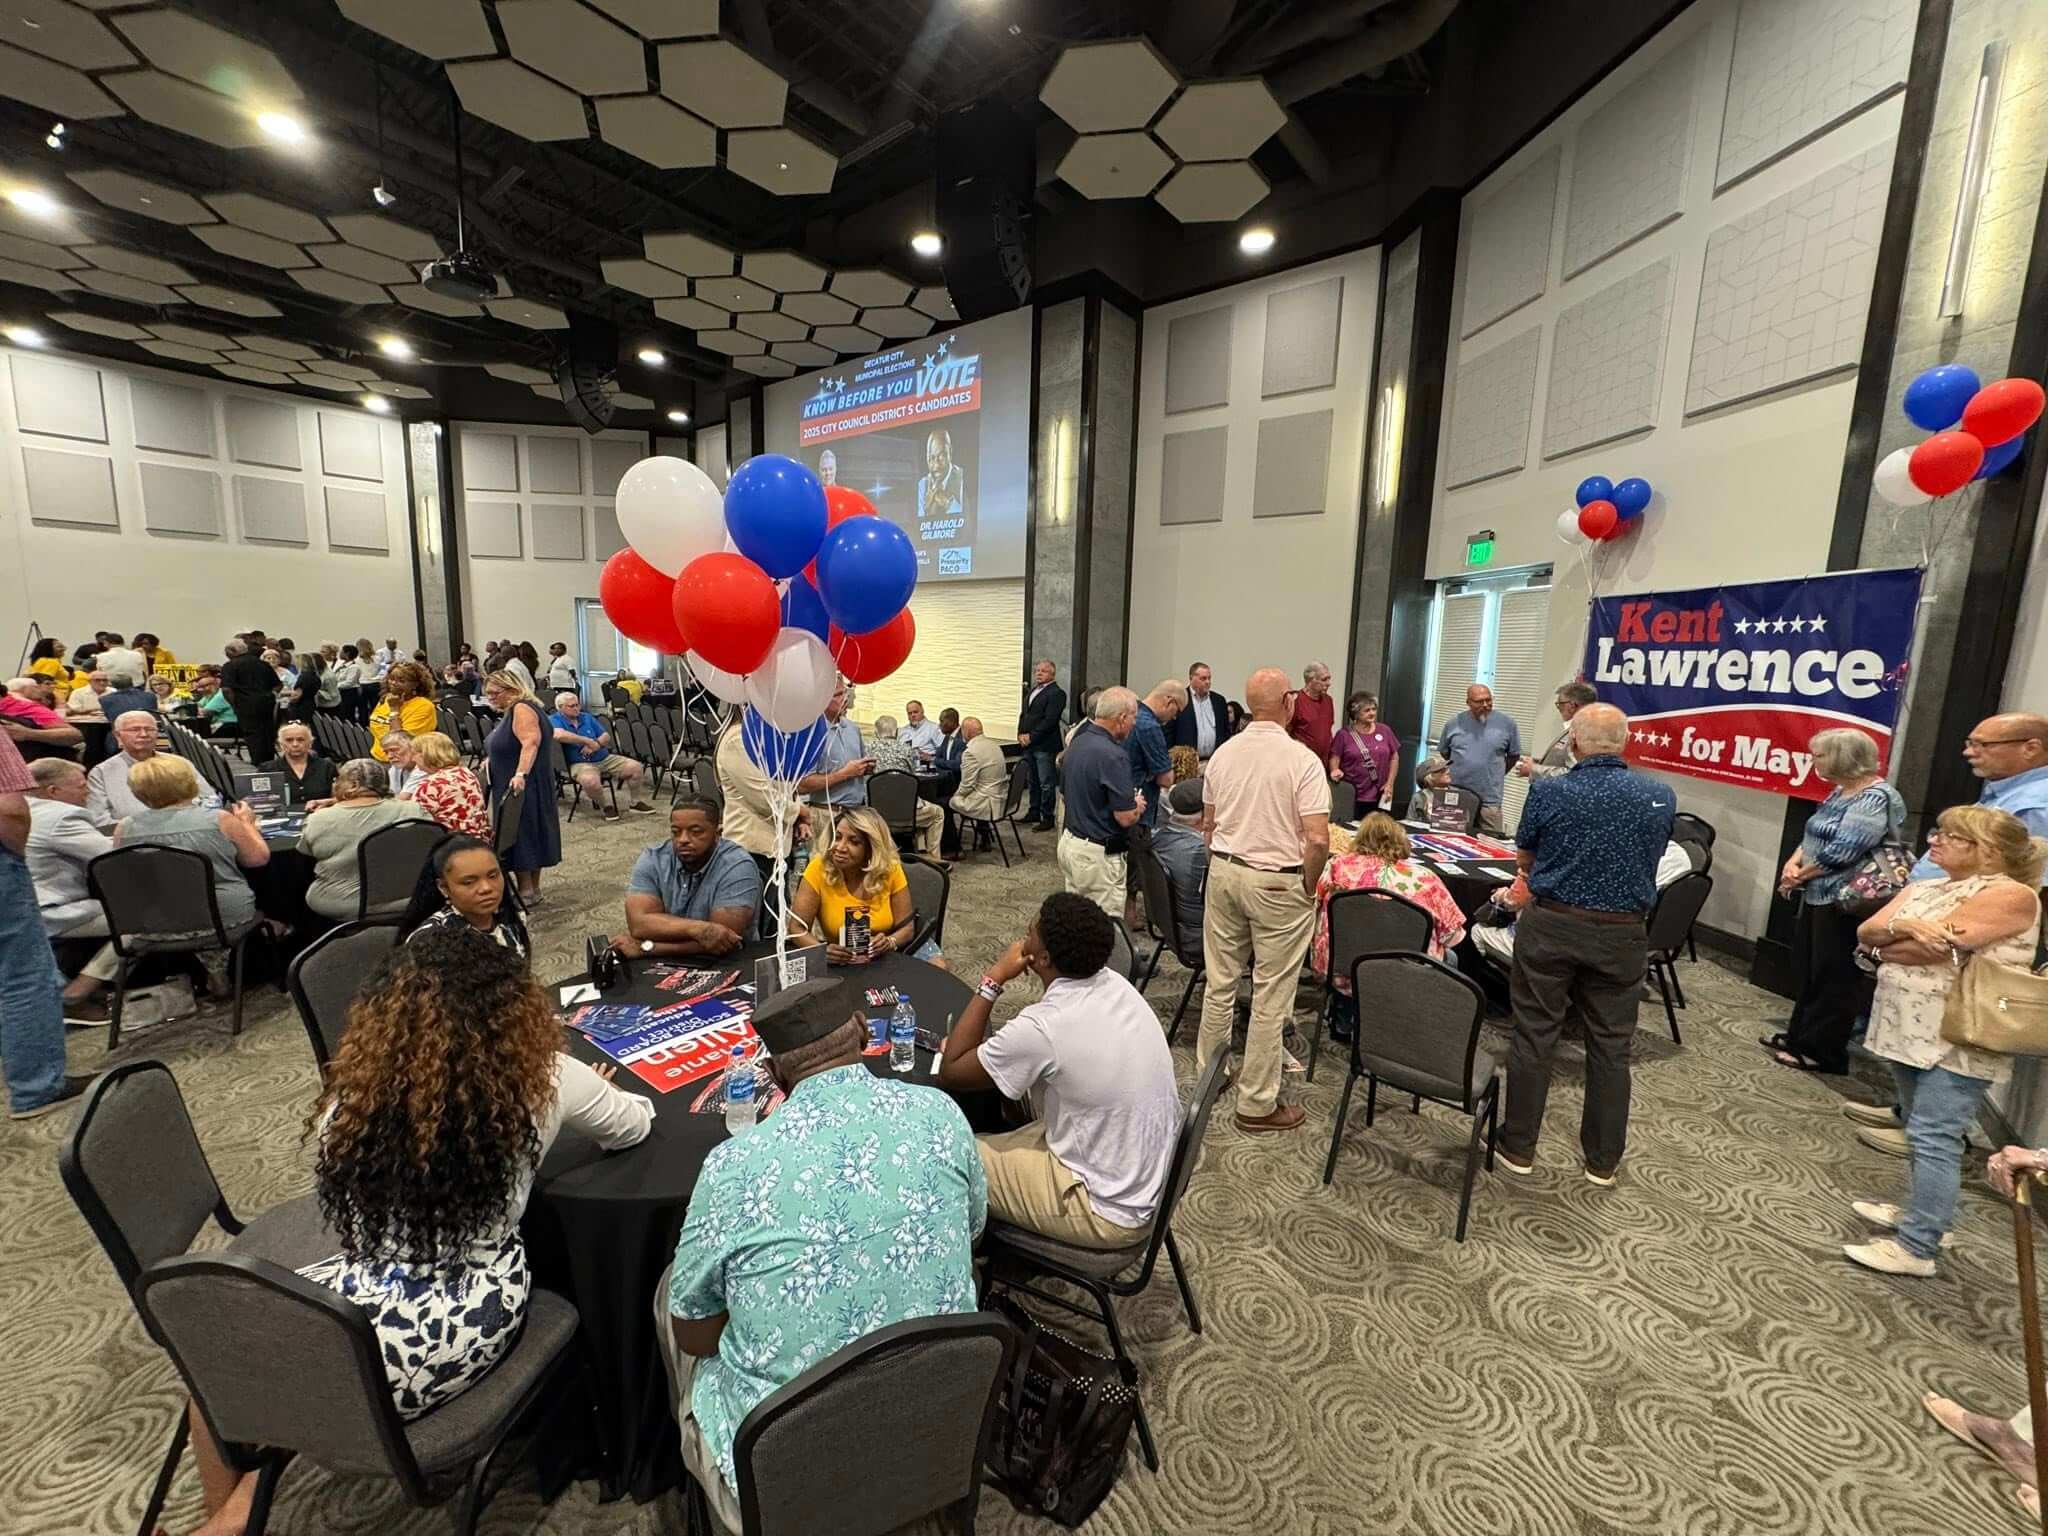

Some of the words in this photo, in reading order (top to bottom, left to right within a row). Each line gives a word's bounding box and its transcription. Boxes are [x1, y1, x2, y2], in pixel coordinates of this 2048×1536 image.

[890, 350, 905, 362] CITY
[803, 399, 837, 418] KNOW
[838, 388, 883, 410] BEFORE
[886, 377, 913, 396] YOU
[916, 354, 979, 398] VOTE
[803, 426, 821, 439] 2025
[821, 422, 837, 434] CITY
[838, 414, 870, 431] COUNCIL
[871, 406, 906, 424] DISTRICT
[908, 404, 914, 416] 5
[915, 390, 972, 413] CANDIDATES
[1616, 600, 1724, 643] Kent
[1595, 637, 1885, 699] Lawrence
[1679, 726, 1726, 762] for
[1731, 734, 1829, 787] May
[618, 1032, 673, 1056] BOARD
[641, 1019, 748, 1065] Allen
[648, 1016, 702, 1038] District
[675, 1012, 731, 1034] SCHOOL
